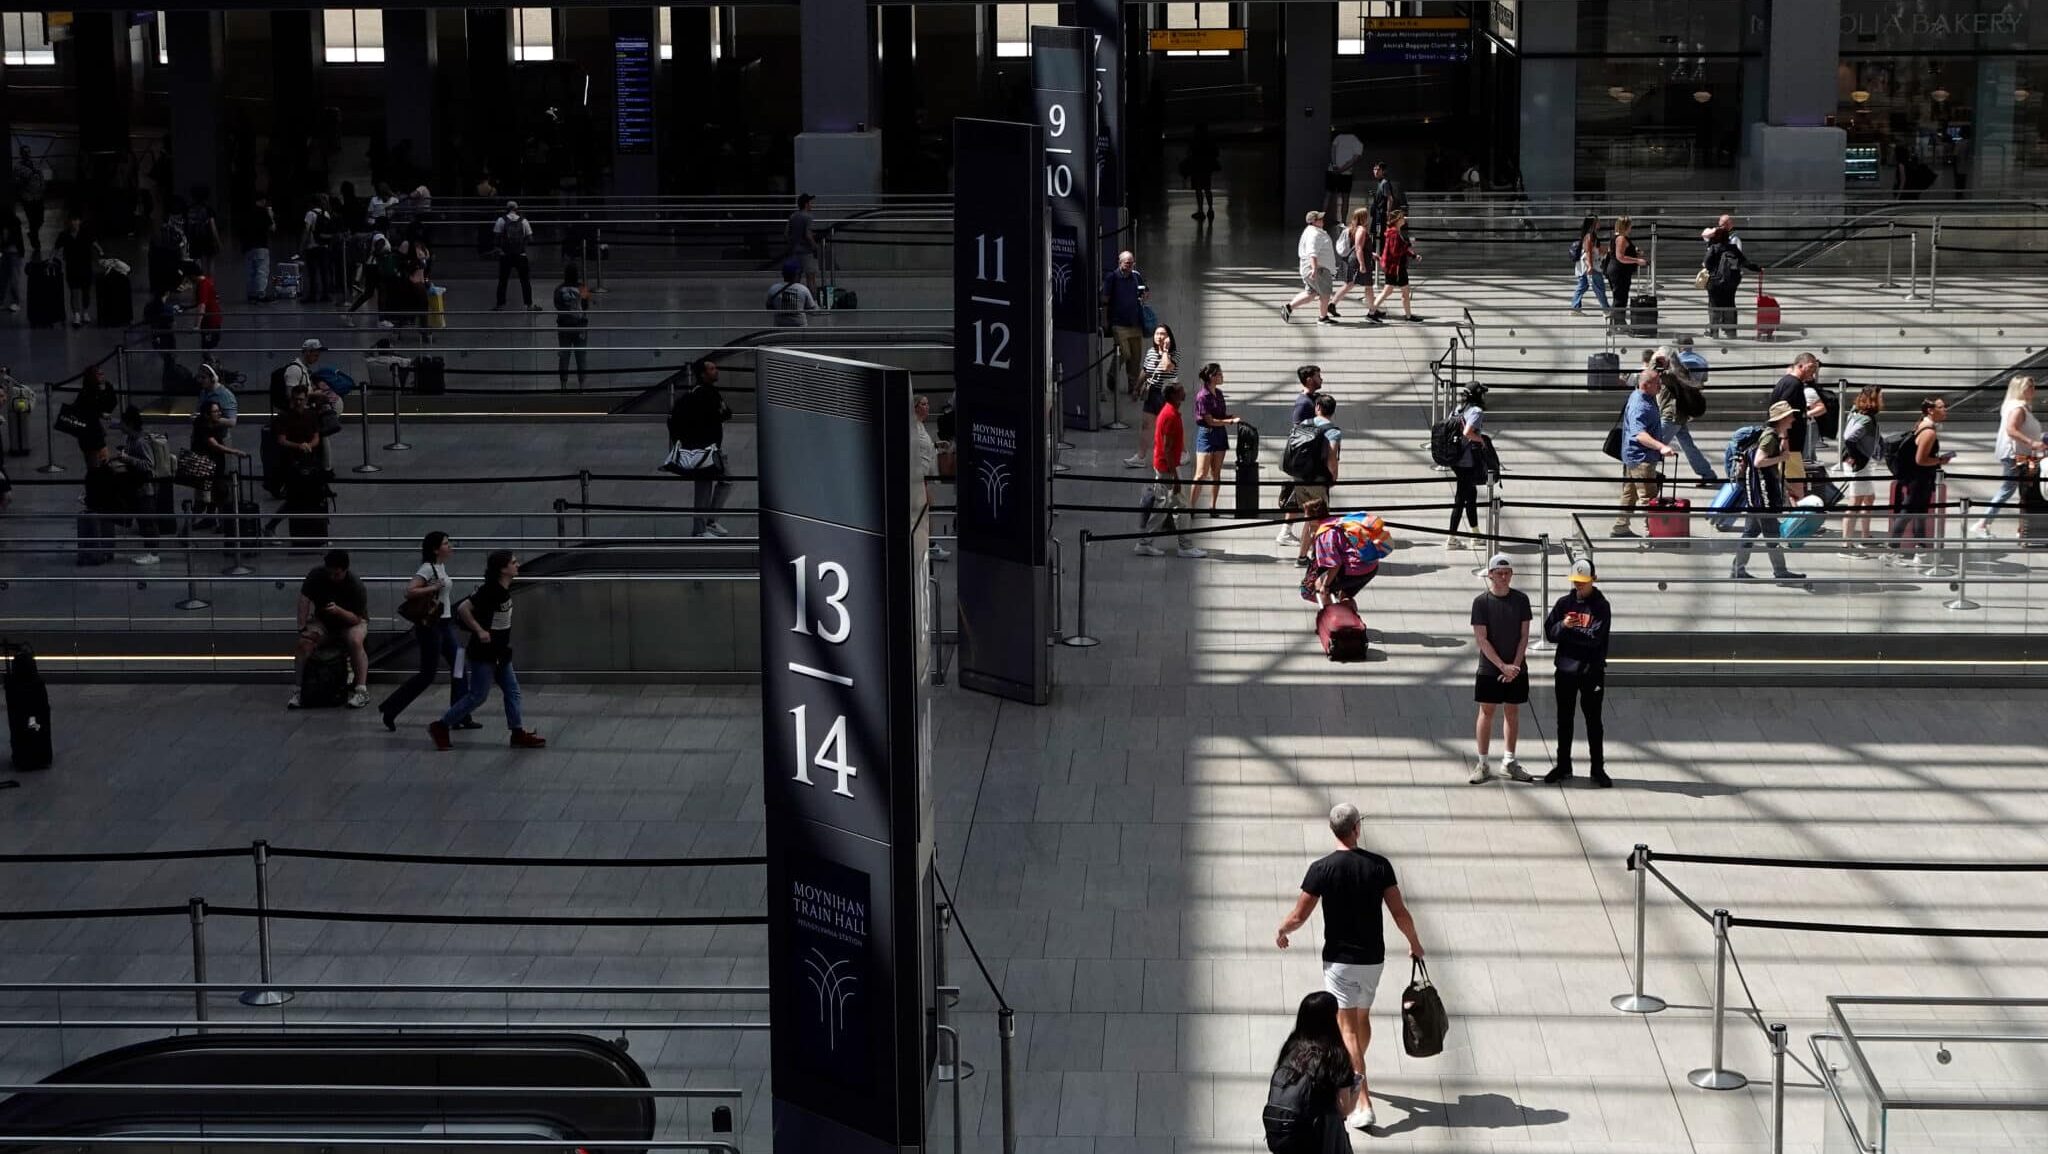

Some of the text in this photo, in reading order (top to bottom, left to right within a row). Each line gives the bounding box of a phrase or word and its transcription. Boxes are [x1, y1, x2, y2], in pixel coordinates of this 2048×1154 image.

[1913, 13, 2024, 34] BAKERY
[1049, 104, 1066, 137] 9
[1046, 164, 1073, 198] 10
[975, 233, 1007, 283] 11
[972, 319, 1011, 370] 12
[972, 422, 1016, 439] MOYNIHAN
[972, 432, 1016, 449] TRAIN HALL
[788, 555, 851, 644] 13
[788, 704, 857, 798] 14
[792, 897, 868, 937] TRAIN HALL
[794, 880, 864, 918] MOYNIHAN
